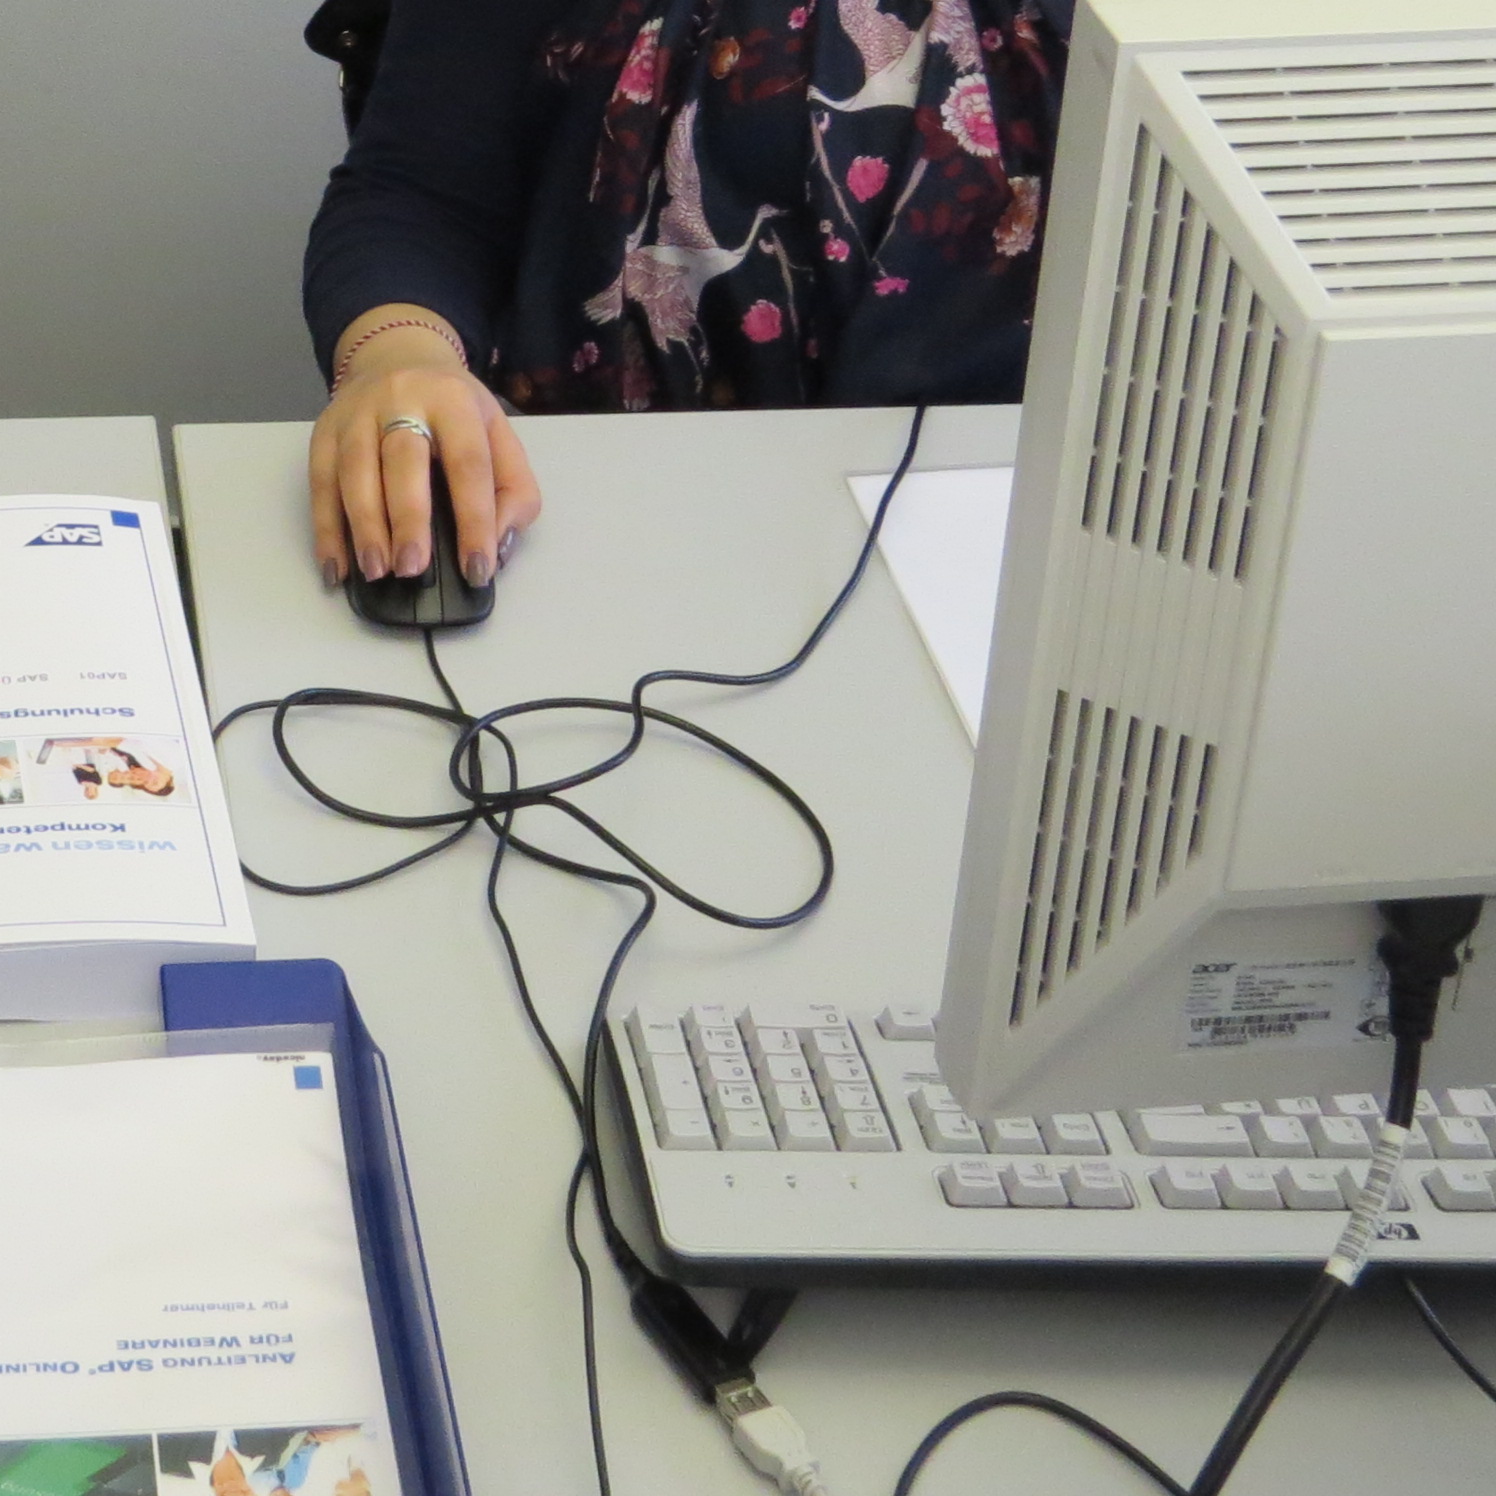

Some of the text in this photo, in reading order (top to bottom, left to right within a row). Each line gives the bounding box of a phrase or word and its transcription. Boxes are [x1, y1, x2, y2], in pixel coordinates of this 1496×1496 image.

[41, 525, 102, 544] SAP
[17, 673, 49, 683] SAP
[51, 839, 177, 854] wissen
[161, 1301, 257, 1313] Teilnehmer
[116, 1335, 242, 1350] WEBINARE
[161, 1351, 297, 1368] ANLEITUNG
